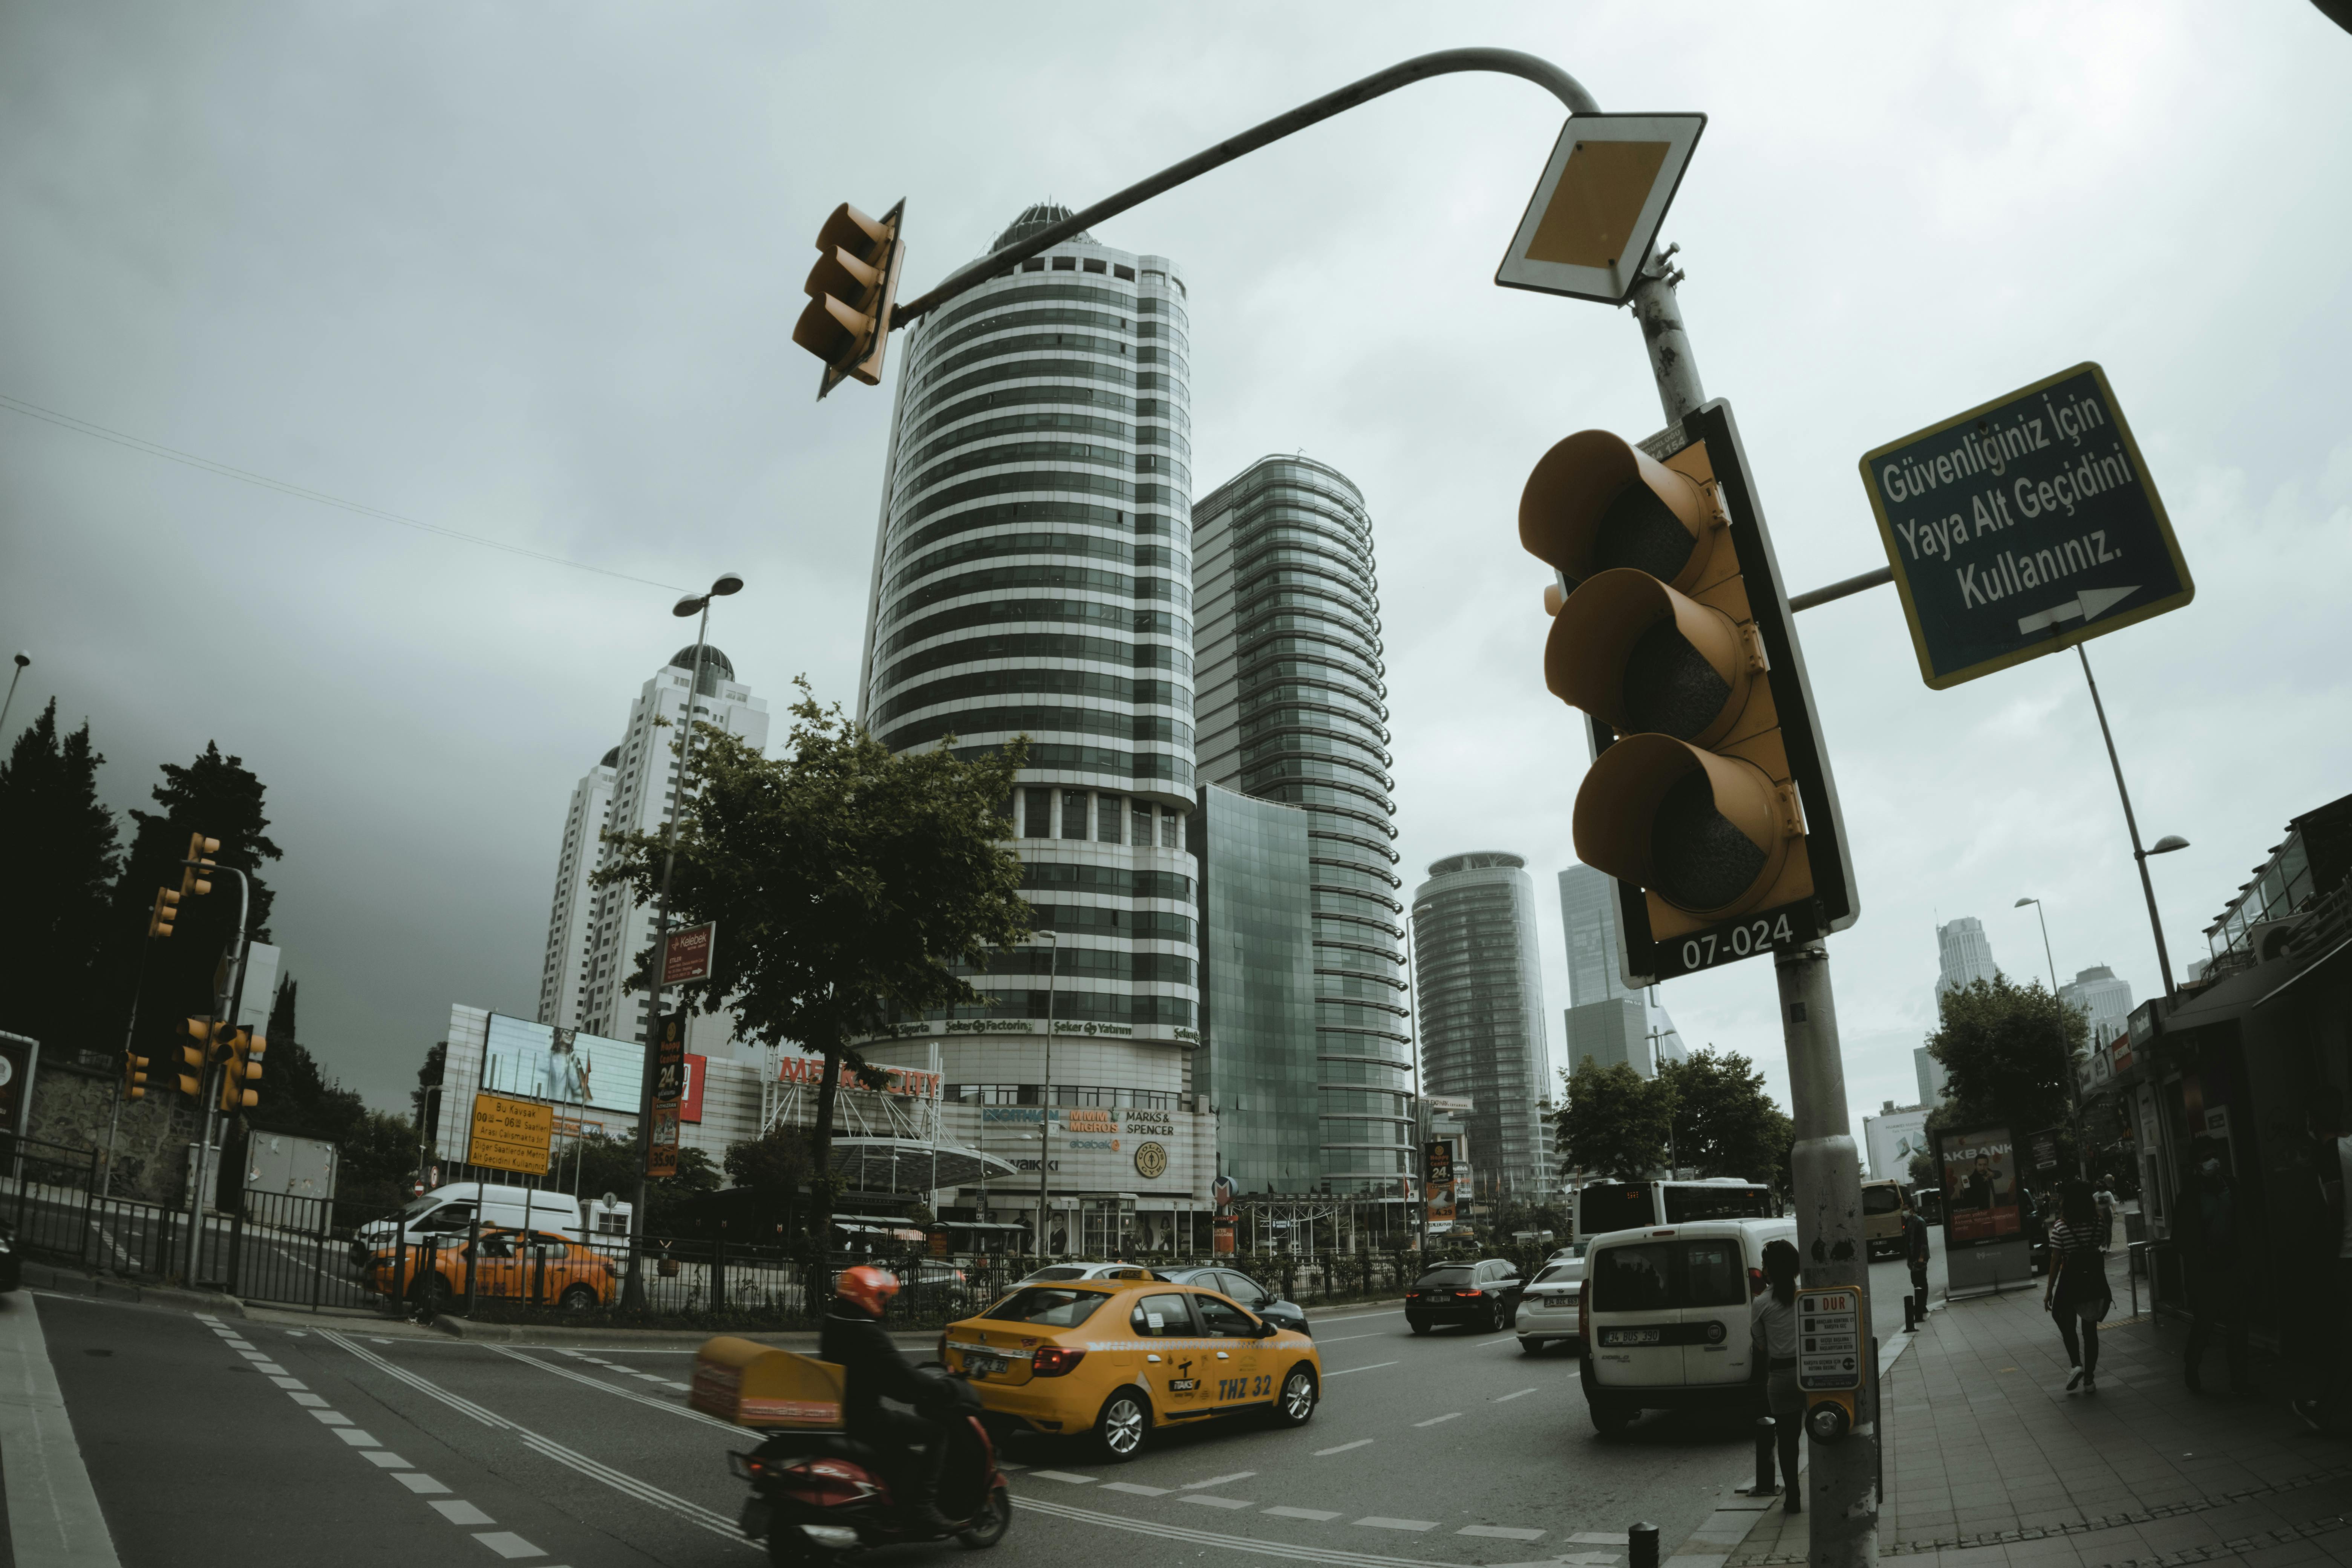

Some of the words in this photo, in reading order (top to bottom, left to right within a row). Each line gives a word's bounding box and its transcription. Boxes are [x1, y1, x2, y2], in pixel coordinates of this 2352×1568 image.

[1666, 436, 1685, 453] 154
[1883, 414, 2050, 503] Güvenliğiniz
[2043, 394, 2104, 446] İçin
[1897, 513, 1968, 561] Yaya
[1973, 488, 2013, 537] Alt
[2015, 442, 2133, 517] Geçidini
[1956, 529, 2122, 609] Kullanınız.
[680, 932, 707, 948] Kelebek
[1682, 913, 1793, 969] 07-024
[899, 1023, 929, 1036] Sigorta
[946, 1020, 972, 1033] Şeker
[1054, 1021, 1082, 1034] Şeker
[1098, 1023, 1132, 1035] Yatırım
[1175, 1028, 1194, 1040] Şeker
[661, 1041, 680, 1053] Happy
[660, 1054, 680, 1064] Center
[778, 1057, 940, 1098] MERCITY
[496, 1102, 506, 1113] Bu
[509, 1105, 536, 1118] Kavşak
[983, 1109, 1059, 1122] DECATHLON
[1127, 1112, 1161, 1122] MARKS
[1163, 1114, 1169, 1123] &
[480, 1126, 497, 1136] Arası
[525, 1122, 549, 1133] Saatleri
[1127, 1124, 1174, 1135] SPENCER
[475, 1141, 492, 1152] Diğer
[494, 1144, 524, 1155] Saatlerde
[526, 1149, 545, 1159] Metro
[1070, 1139, 1111, 1150] ebebek
[473, 1152, 482, 1161] Alt
[1943, 1144, 2013, 1162] AKBANK
[1006, 1159, 1058, 1171] waikki
[1141, 1165, 1163, 1175] GYM
[1823, 1297, 1845, 1310] DUR
[1610, 1332, 1619, 1342] 34
[1623, 1331, 1638, 1341] BUS
[1642, 1331, 1657, 1340] 390
[1219, 1378, 1248, 1401] THZ
[1253, 1375, 1271, 1396] 32
